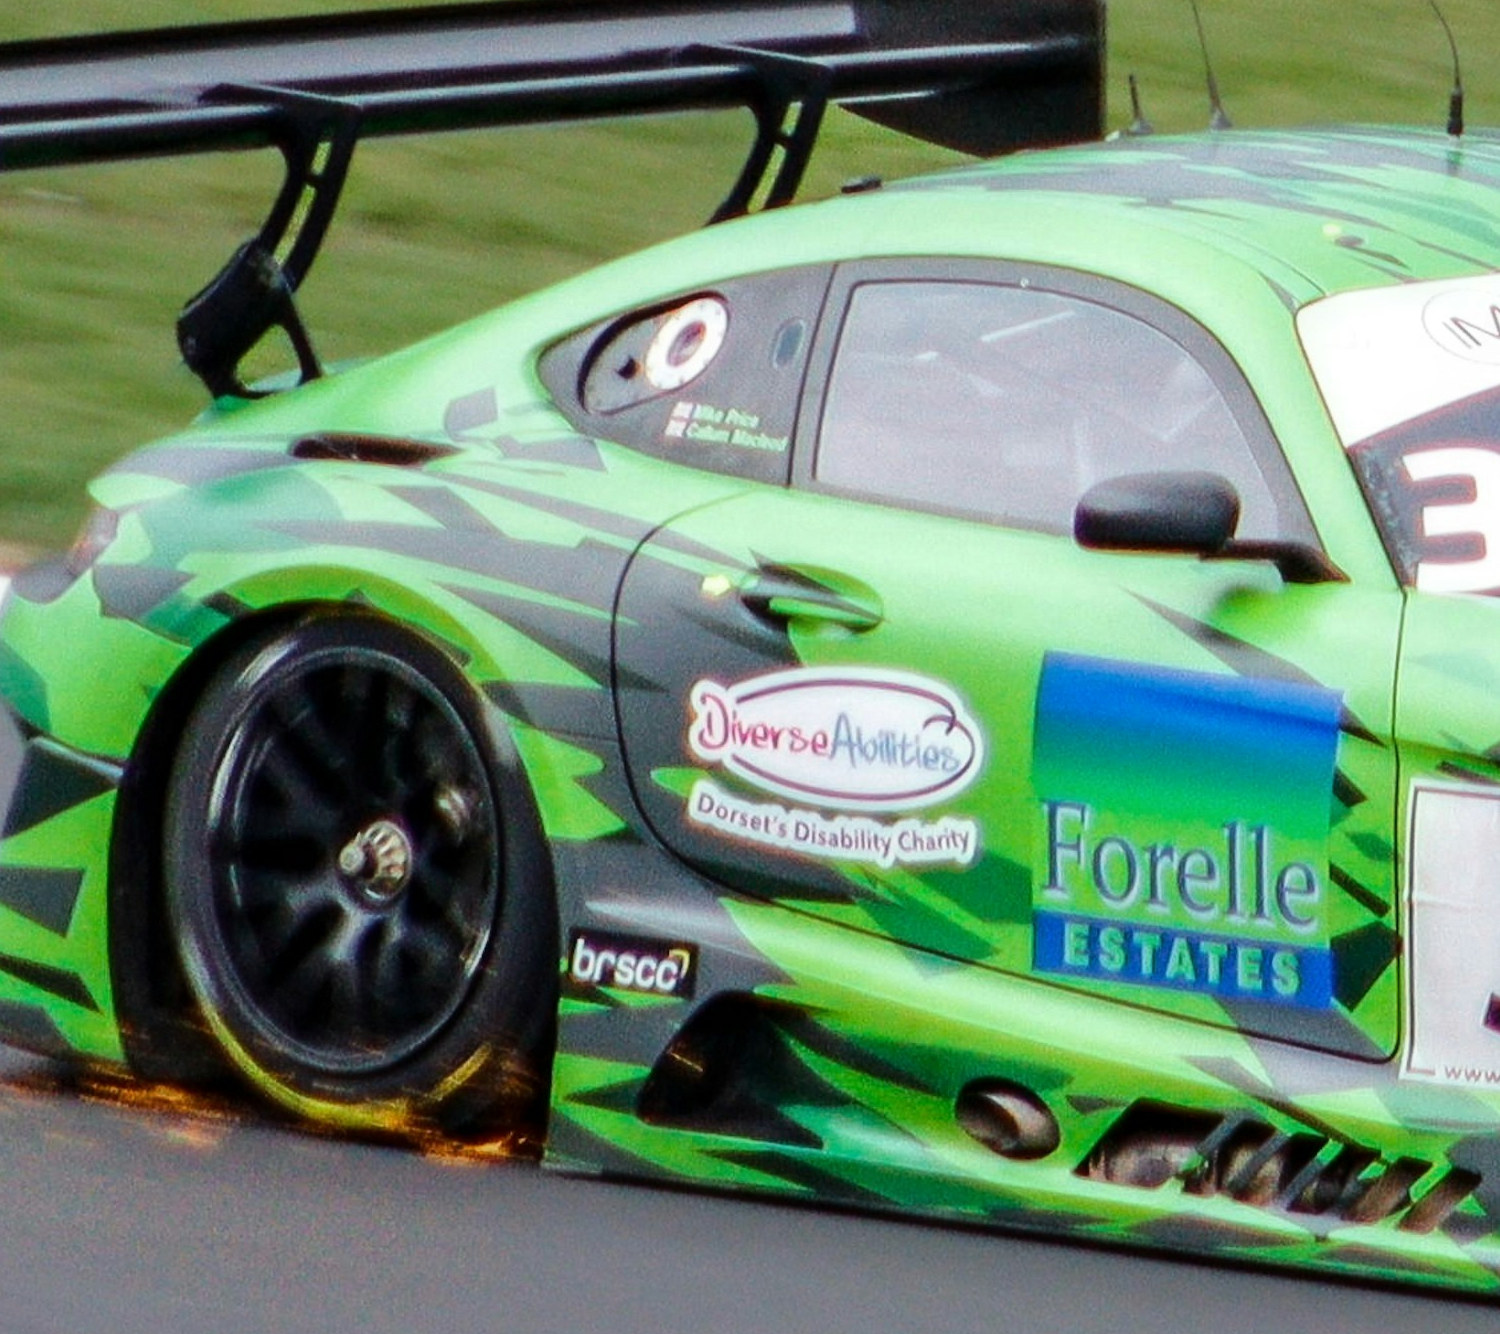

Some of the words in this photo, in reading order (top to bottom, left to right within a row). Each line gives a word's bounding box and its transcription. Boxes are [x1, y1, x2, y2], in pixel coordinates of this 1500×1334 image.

[697, 794, 788, 839] Dorset's
[794, 820, 892, 854] Disability
[897, 826, 970, 853] Charity
[1041, 798, 1319, 934] Forelle
[572, 938, 679, 992] brscc
[1063, 921, 1300, 996] ESTATES
